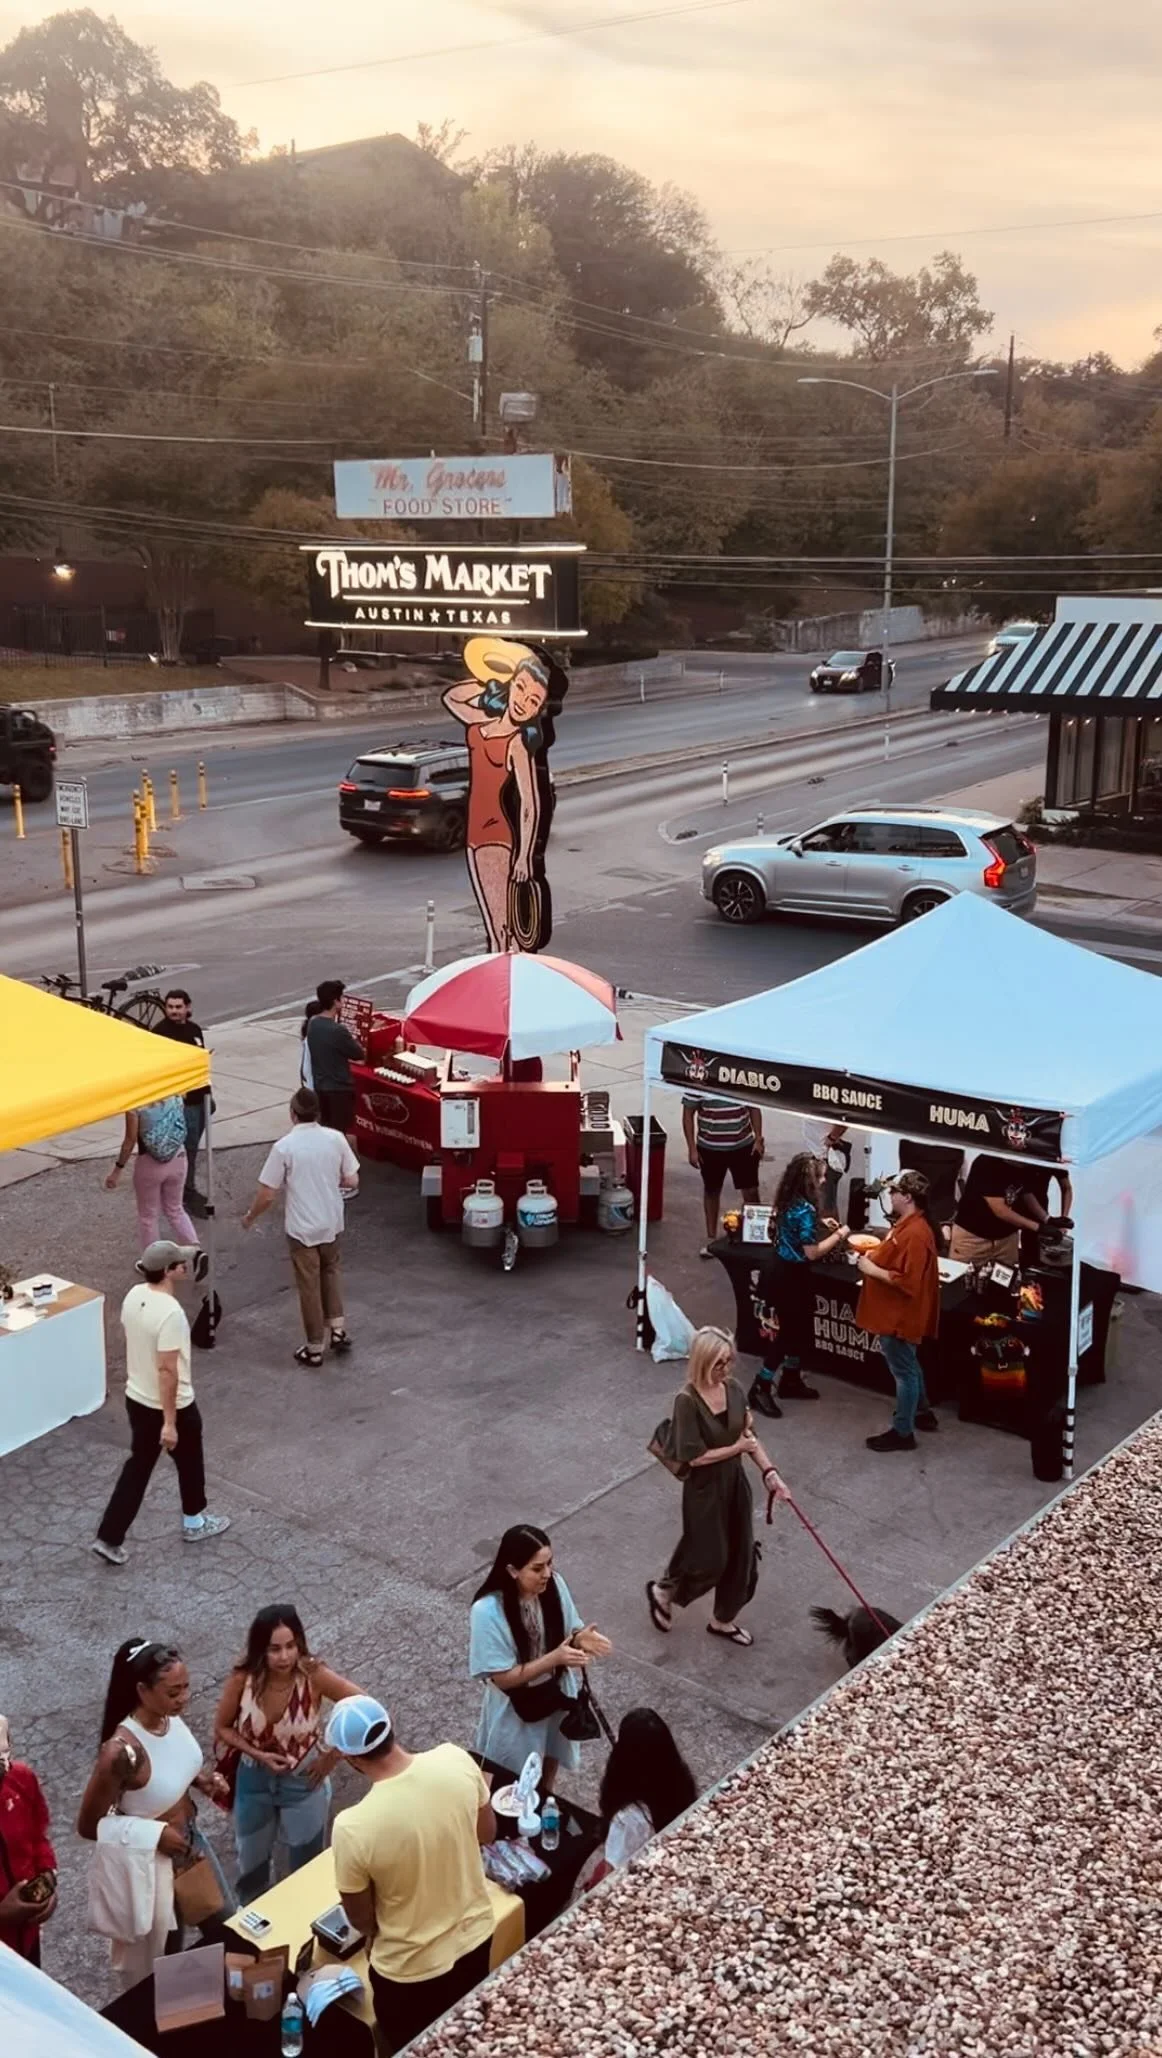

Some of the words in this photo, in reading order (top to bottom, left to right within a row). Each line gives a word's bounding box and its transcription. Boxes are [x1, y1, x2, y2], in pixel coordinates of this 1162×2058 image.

[315, 550, 417, 599] THOM'S
[424, 554, 553, 599] MARKET
[355, 606, 424, 622] AUSTIN
[446, 608, 512, 625] TEXAS
[718, 1066, 781, 1092] DIABLO
[812, 1083, 839, 1101] BBQ
[841, 1088, 883, 1110] SAUCE
[929, 1104, 990, 1133] HUMA
[814, 1316, 882, 1352] HUMA
[814, 1337, 834, 1353] BBQ
[835, 1344, 865, 1362] SAUCE
